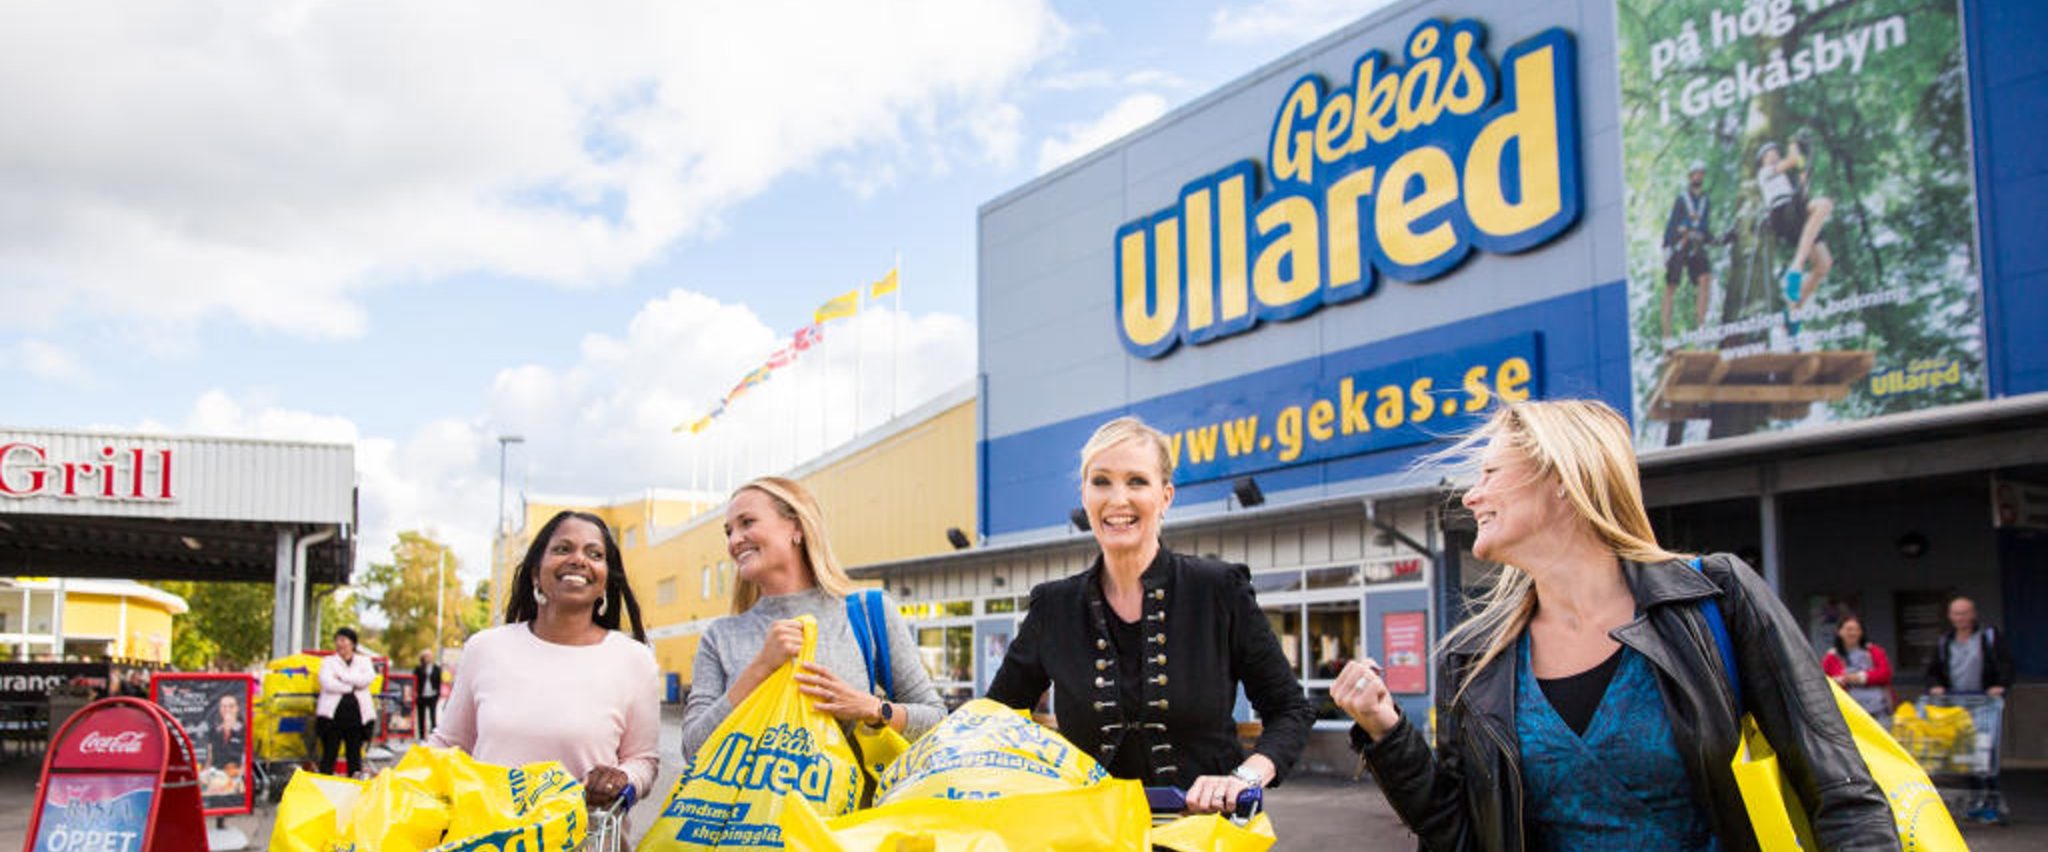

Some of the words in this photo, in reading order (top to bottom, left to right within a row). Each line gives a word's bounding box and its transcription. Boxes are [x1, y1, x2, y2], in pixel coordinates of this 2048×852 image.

[1641, 18, 1702, 81] på
[1659, 88, 1670, 125] i
[1680, 15, 1907, 117] Gekåsbyn
[1272, 26, 1487, 184] Gekås
[1120, 44, 1562, 347] Ullared
[0, 442, 172, 499] Grill
[47, 824, 136, 852] ÖPPET
